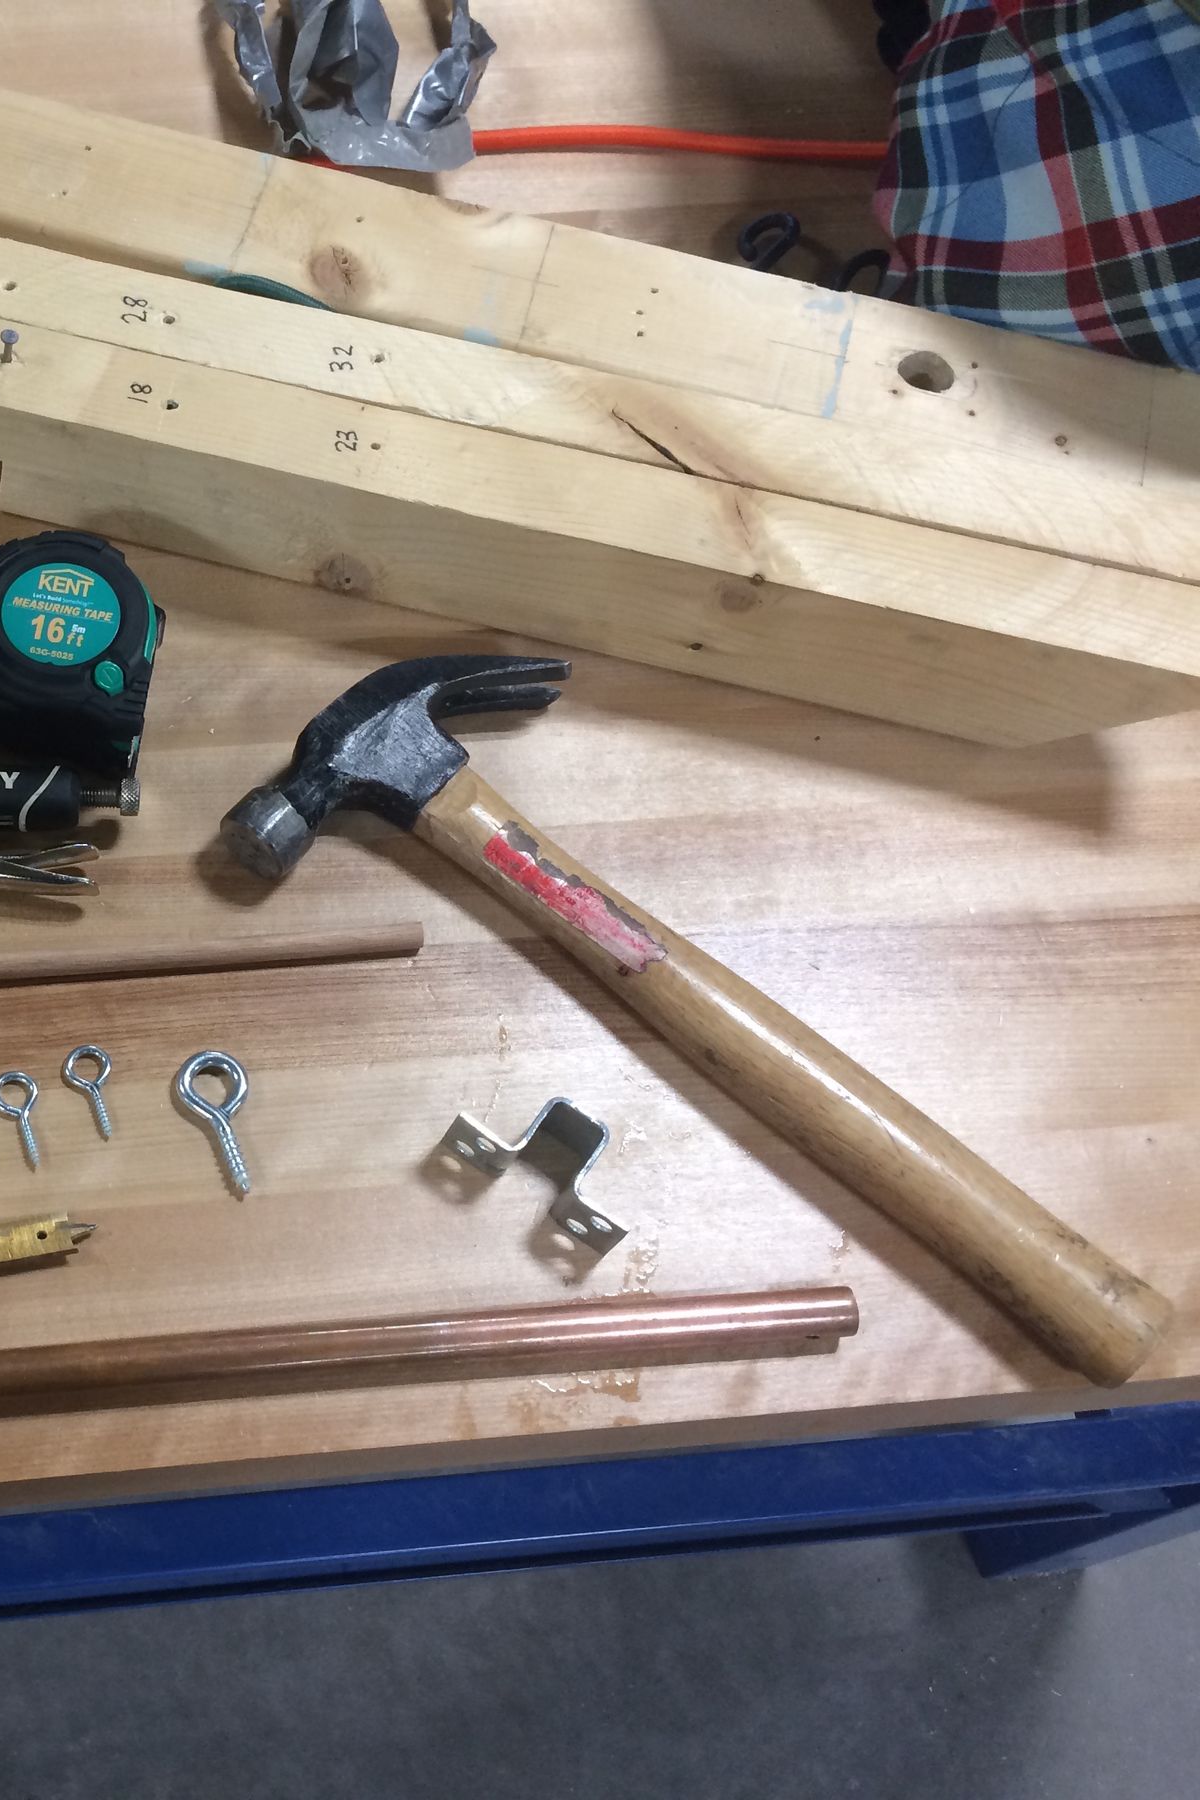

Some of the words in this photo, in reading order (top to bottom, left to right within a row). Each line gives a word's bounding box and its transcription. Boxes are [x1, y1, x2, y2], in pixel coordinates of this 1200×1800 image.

[120, 295, 148, 324] 28
[328, 345, 354, 372] 32
[127, 382, 153, 404] 18
[334, 430, 359, 452] 23
[38, 573, 94, 598] KENT
[12, 596, 81, 617] MEASURING
[84, 608, 114, 622] TAPE
[31, 614, 66, 644] 16
[66, 632, 85, 647] ft
[71, 623, 87, 634] 5m
